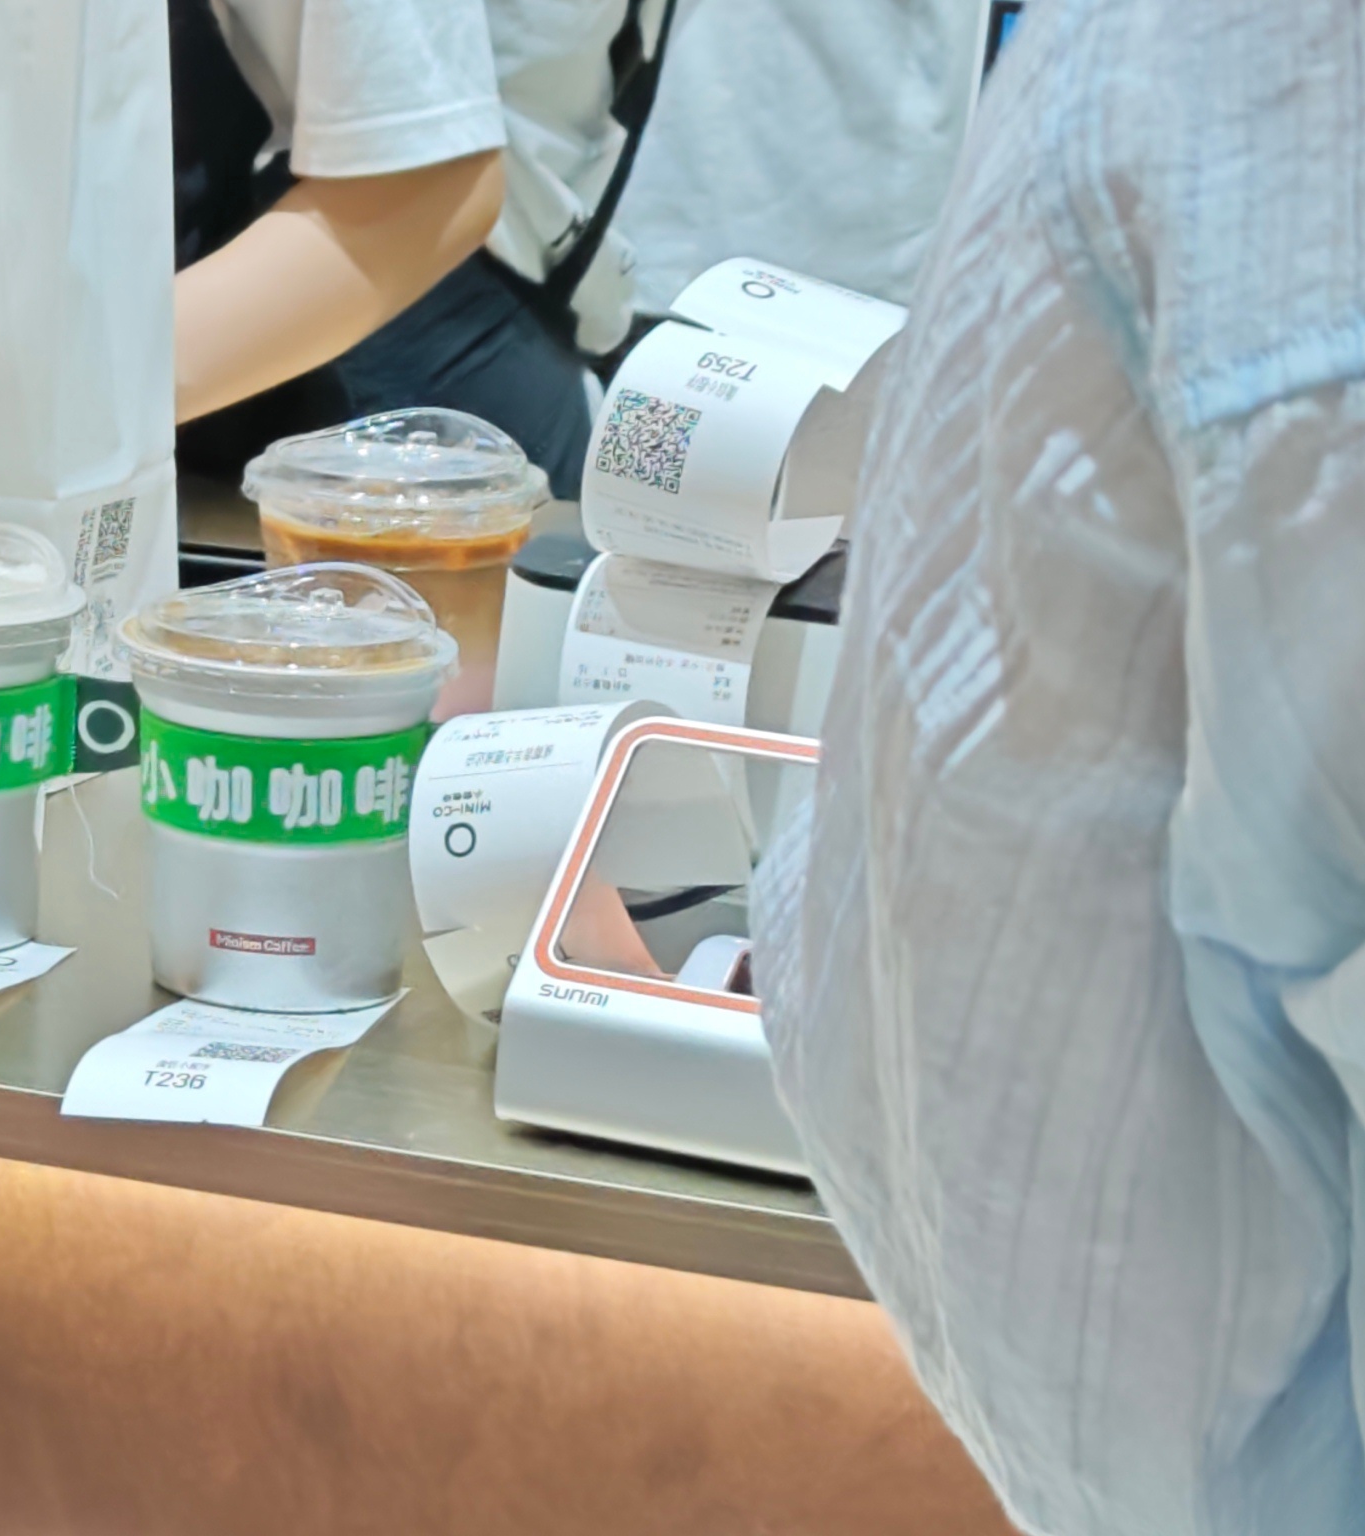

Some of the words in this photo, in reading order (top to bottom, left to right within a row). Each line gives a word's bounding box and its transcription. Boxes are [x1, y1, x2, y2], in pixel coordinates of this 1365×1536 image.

[696, 351, 759, 382] T259
[141, 740, 411, 830] 小咖咖啡
[143, 1069, 209, 1090] T236
